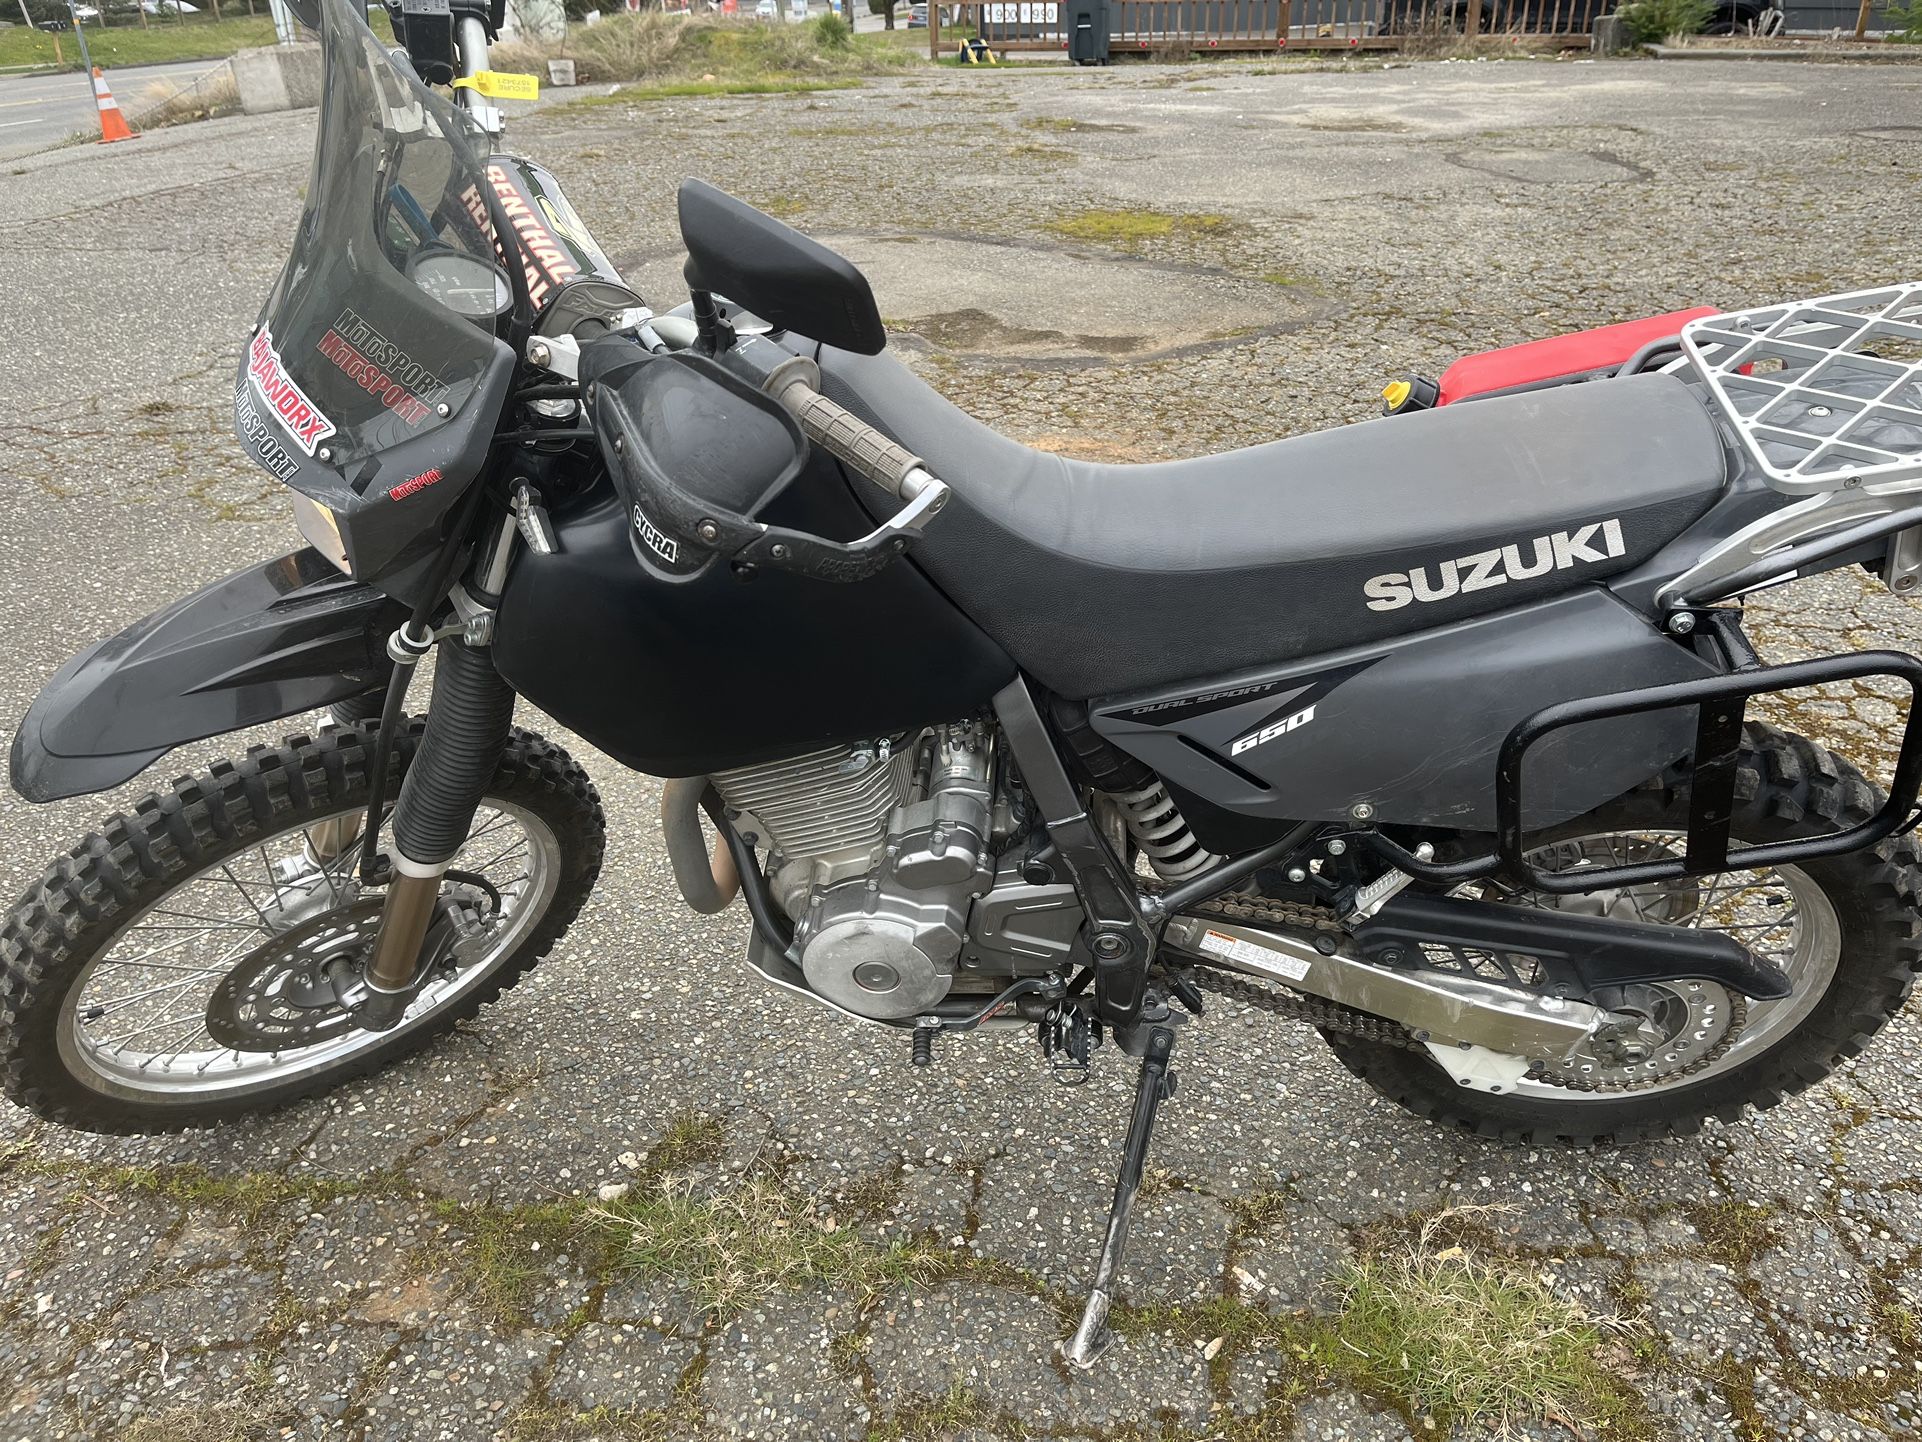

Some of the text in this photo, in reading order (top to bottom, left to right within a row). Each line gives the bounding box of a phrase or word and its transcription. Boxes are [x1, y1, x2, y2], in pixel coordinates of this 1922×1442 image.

[498, 85, 532, 93] SECURE
[487, 165, 576, 286] RENTHAL
[250, 330, 326, 445] BAJAWORX
[633, 504, 677, 563] CYCRA
[1363, 518, 1625, 611] SUZUKI
[1131, 682, 1278, 715] DUAL SPORT
[1231, 705, 1317, 756] 650
